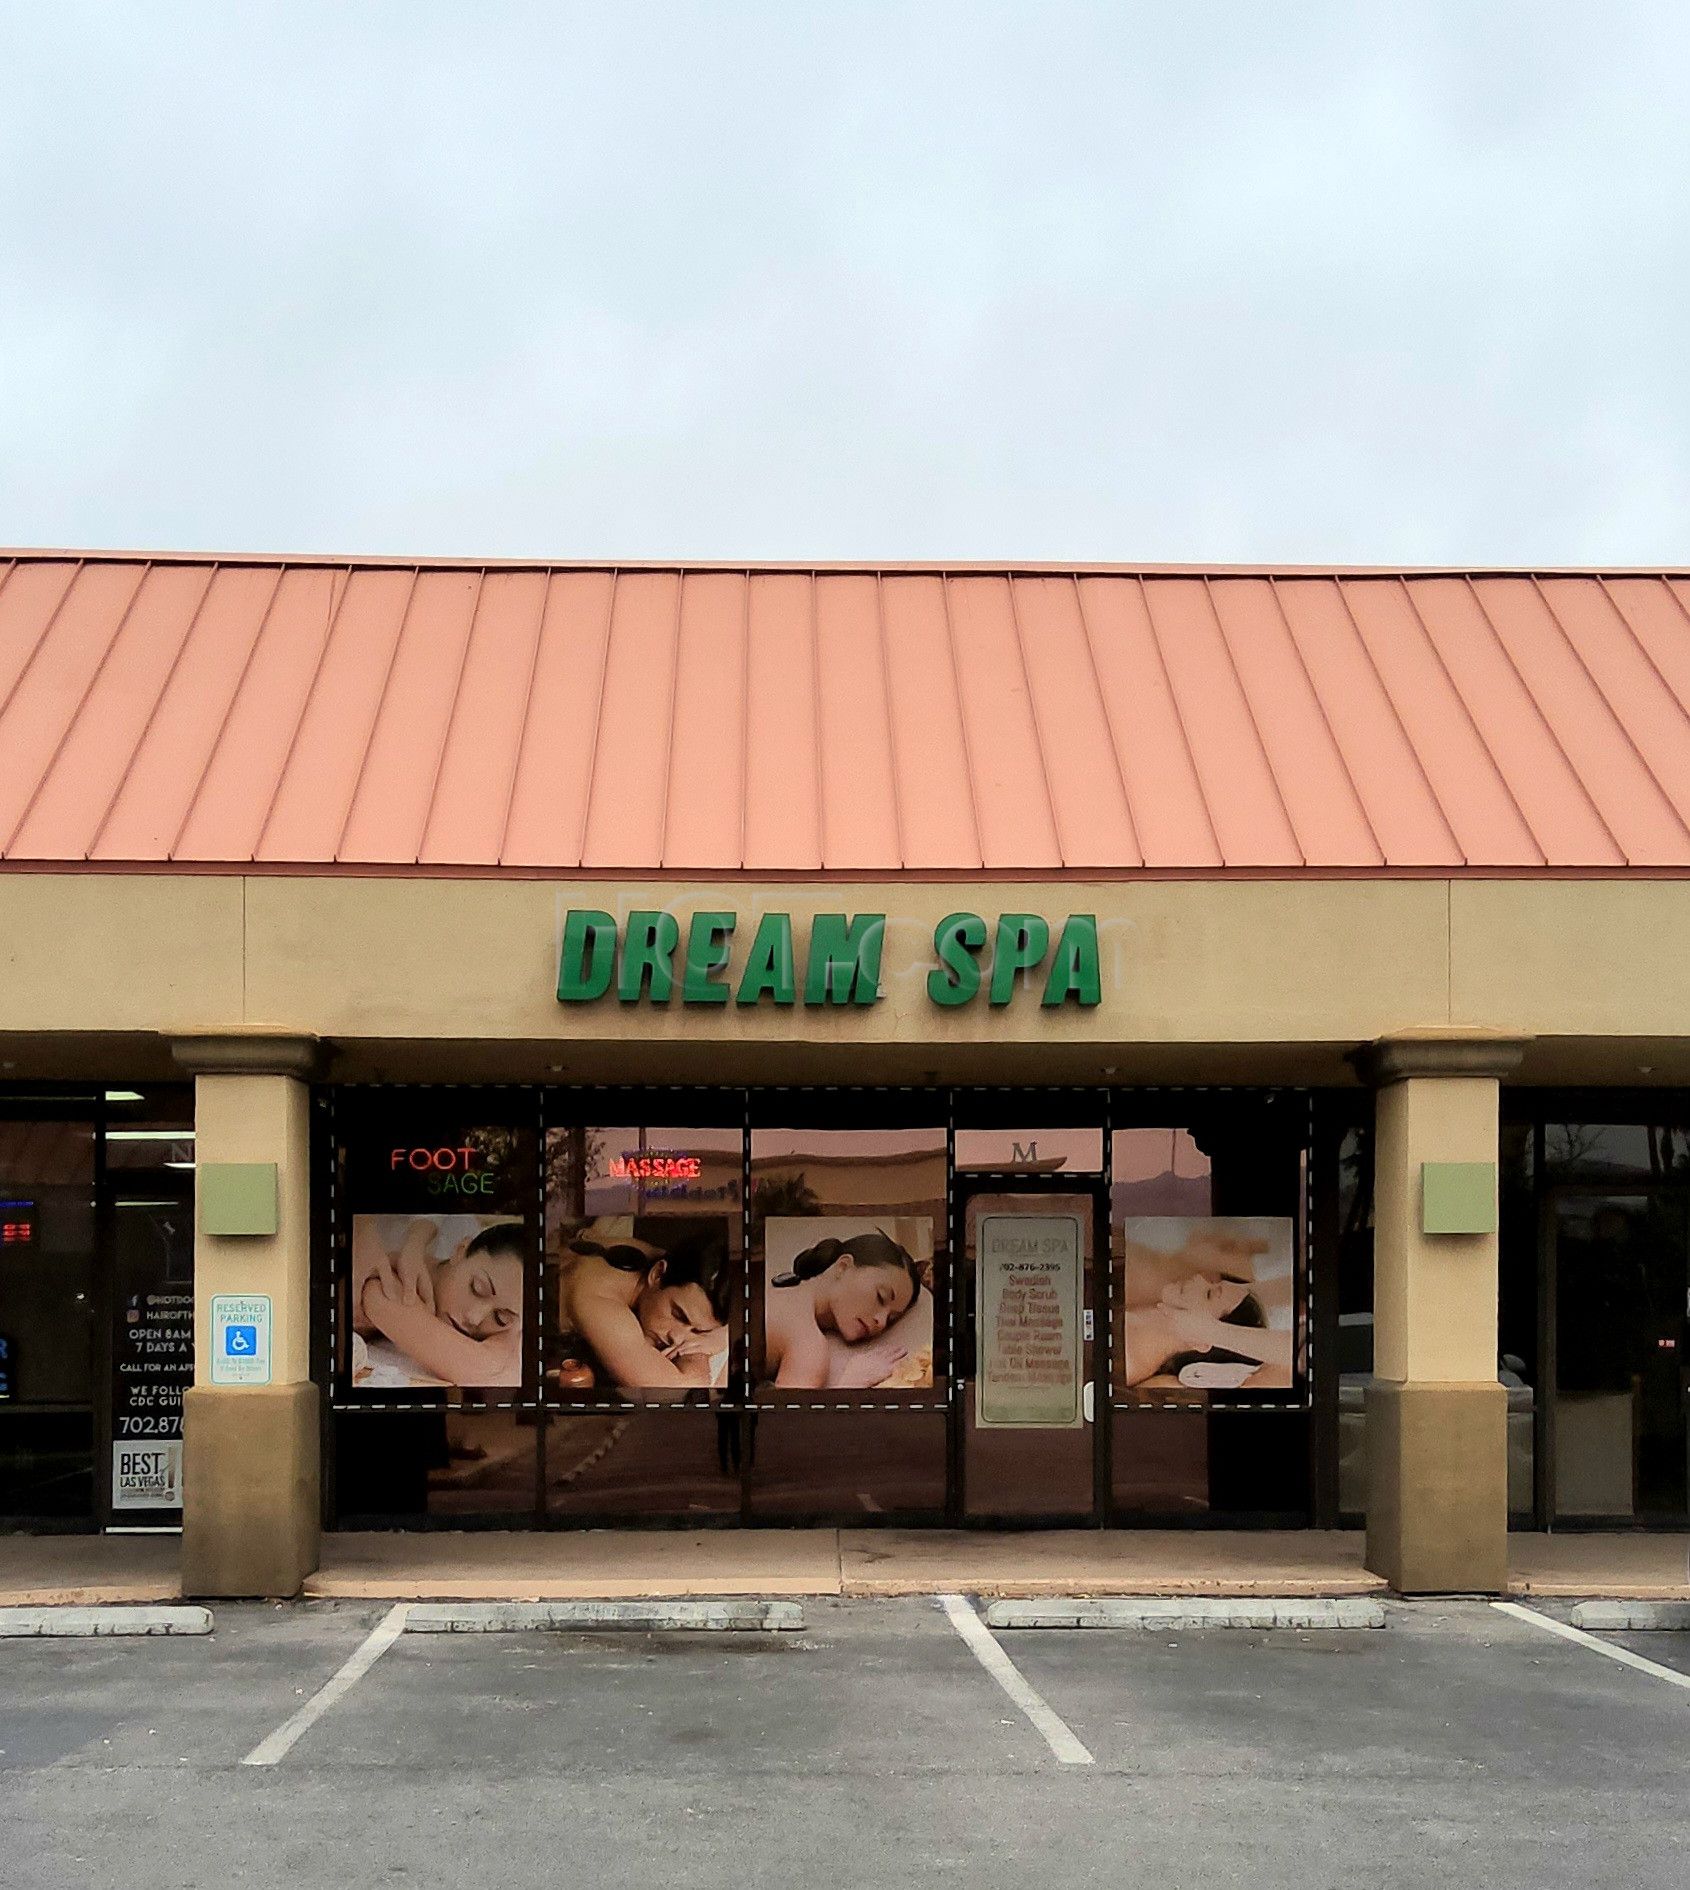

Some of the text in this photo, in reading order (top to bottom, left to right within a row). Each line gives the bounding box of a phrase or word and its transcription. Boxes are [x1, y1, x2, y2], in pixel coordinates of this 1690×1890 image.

[557, 910, 1102, 1006] DREAM SPA
[391, 1148, 478, 1171] FOOT
[1012, 1141, 1037, 1166] M
[609, 1156, 701, 1178] MASSAGE
[1042, 1238, 1068, 1253] SPA
[217, 1303, 267, 1313] RESERVED
[221, 1313, 263, 1323] PARKING
[129, 1329, 192, 1339] OPEN 8AM
[135, 1342, 143, 1353] 7
[147, 1342, 175, 1353] DAYS
[178, 1342, 188, 1353] A
[120, 1363, 143, 1372] CALL
[143, 1364, 161, 1372] FOR
[163, 1364, 177, 1372] AN
[130, 1386, 148, 1396] WE
[129, 1396, 181, 1407] CDC GUI
[119, 1416, 184, 1434] 702.87
[121, 1453, 165, 1475] BEST
[121, 1475, 166, 1488] LAS VEGAS
